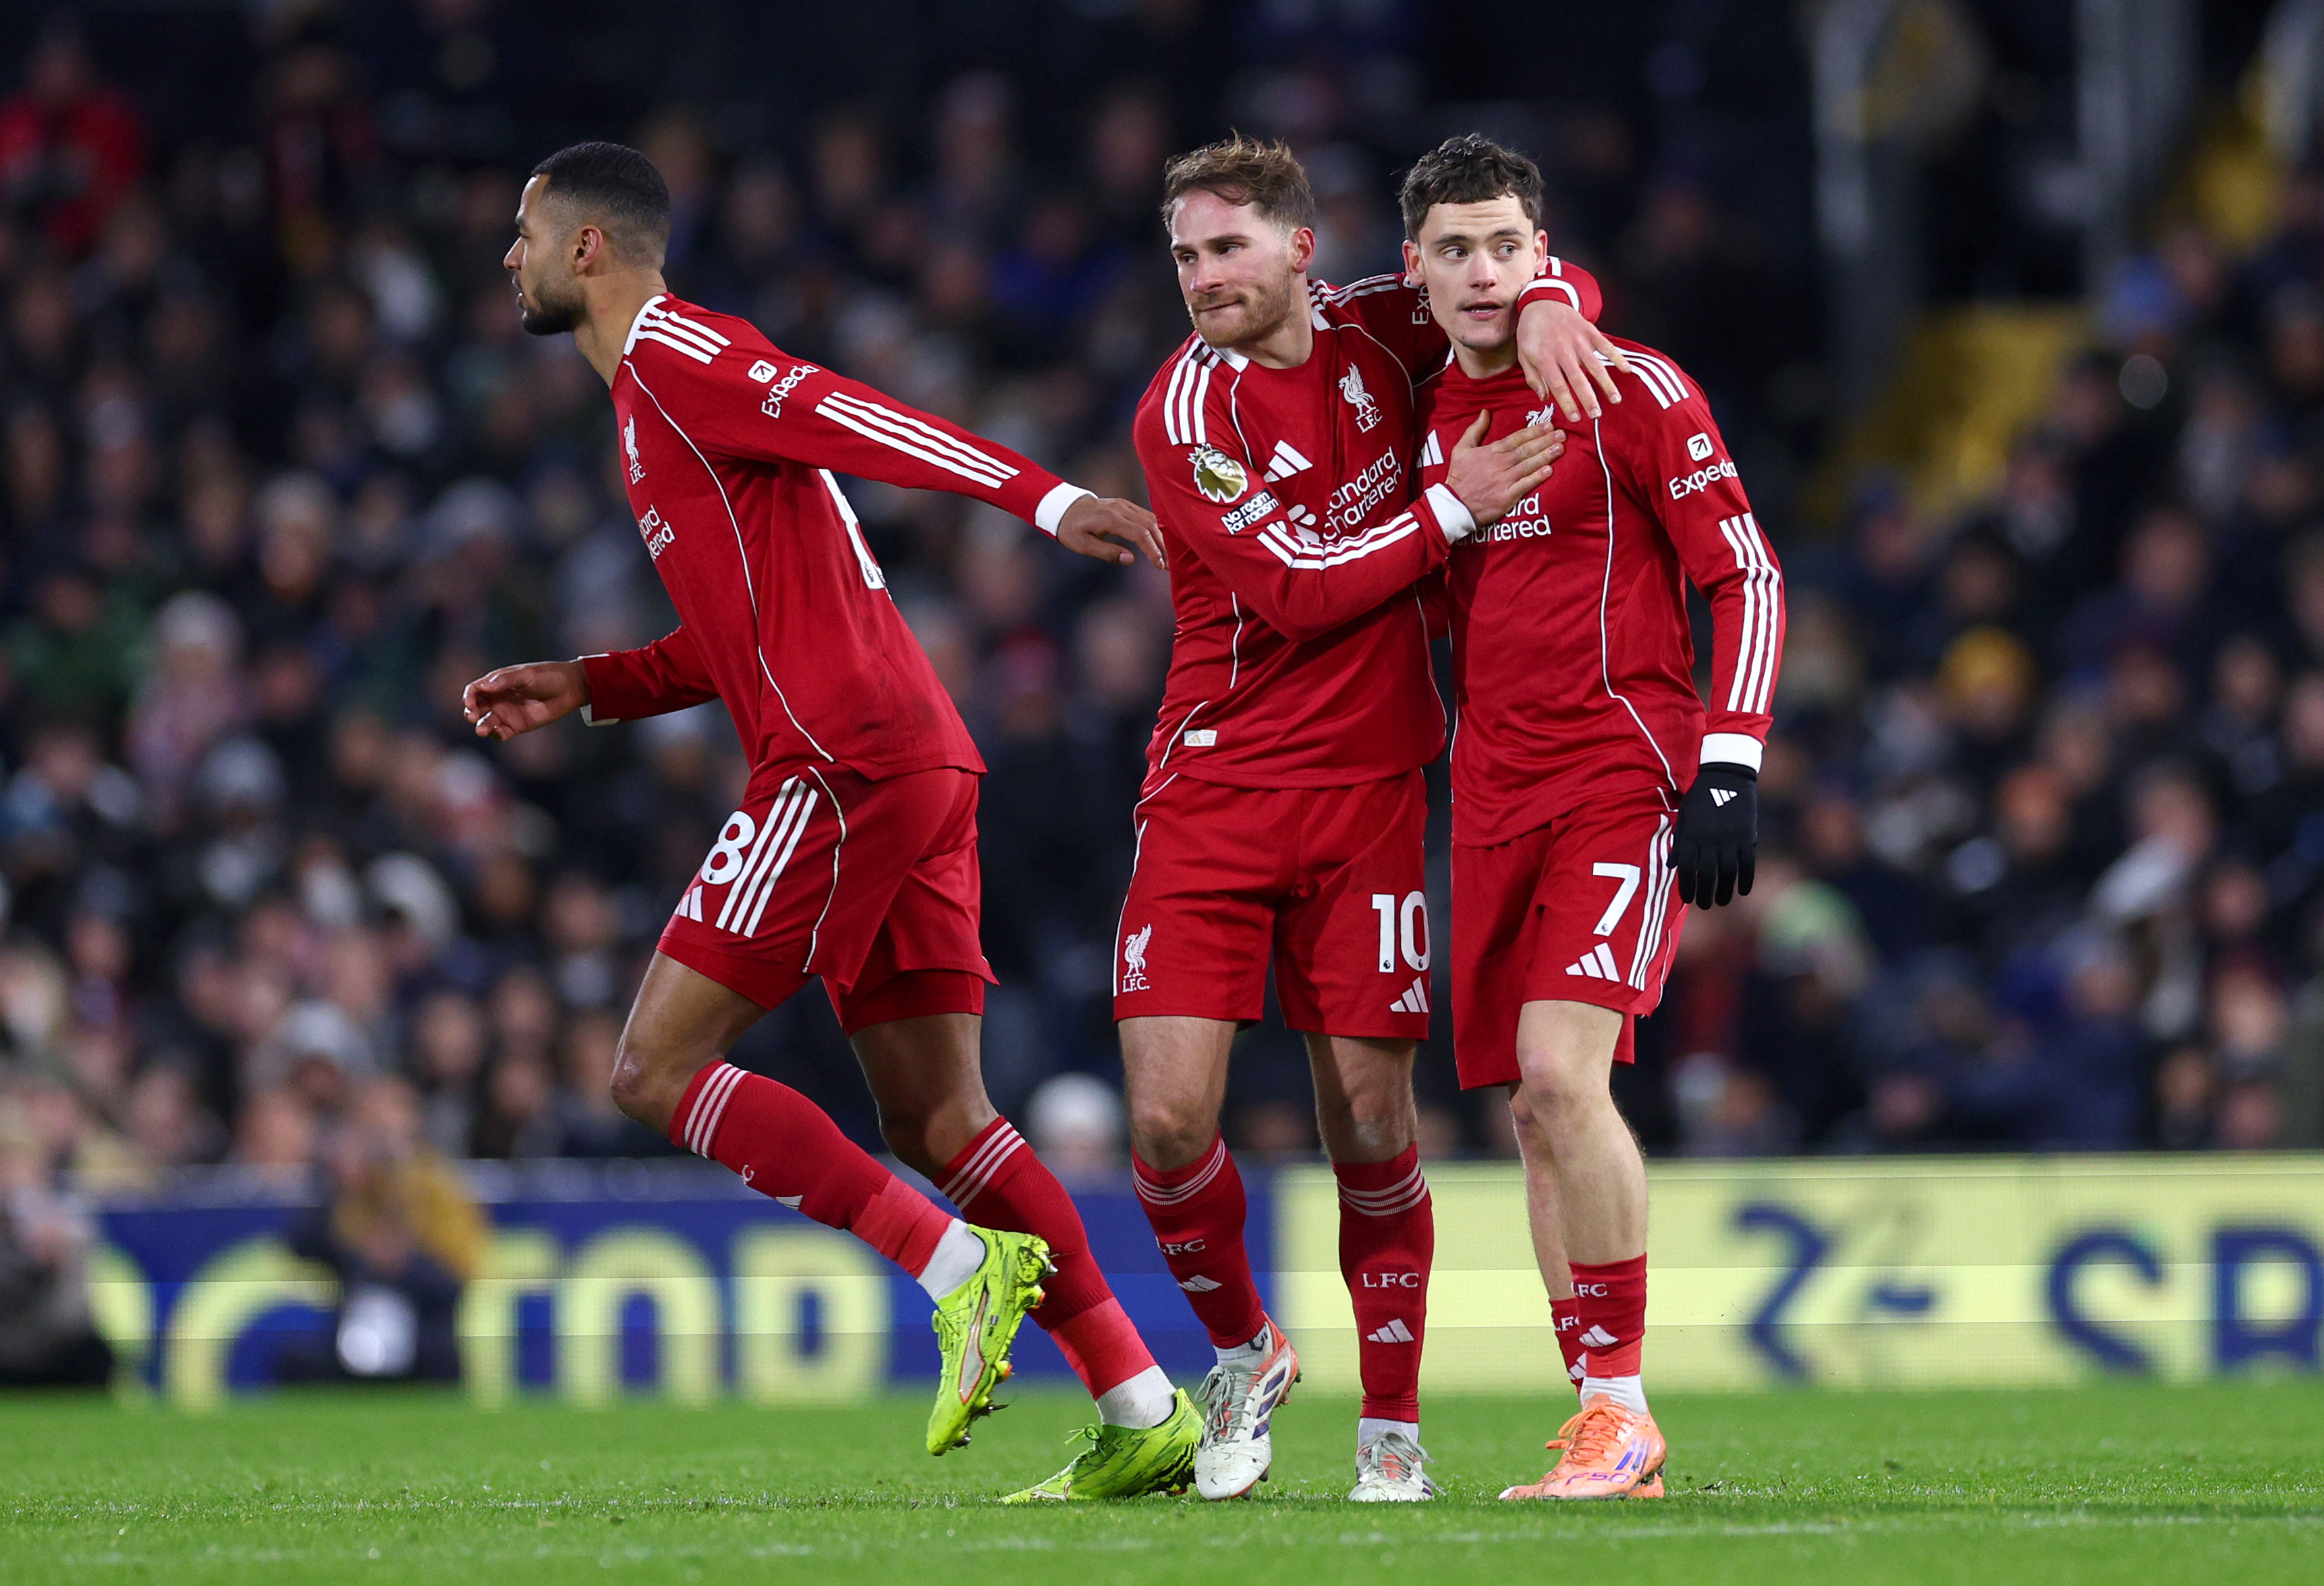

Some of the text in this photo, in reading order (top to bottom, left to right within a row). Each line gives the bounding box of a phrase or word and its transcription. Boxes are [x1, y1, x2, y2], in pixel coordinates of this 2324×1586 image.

[761, 365, 821, 419] Expeda
[1669, 458, 1738, 500] Expeda
[1221, 492, 1271, 528] No room
[700, 811, 756, 885] 8
[1592, 862, 1641, 936] 7
[1372, 890, 1431, 973] 10
[1155, 1236, 1206, 1255] LFC
[1362, 1272, 1419, 1288] LFC
